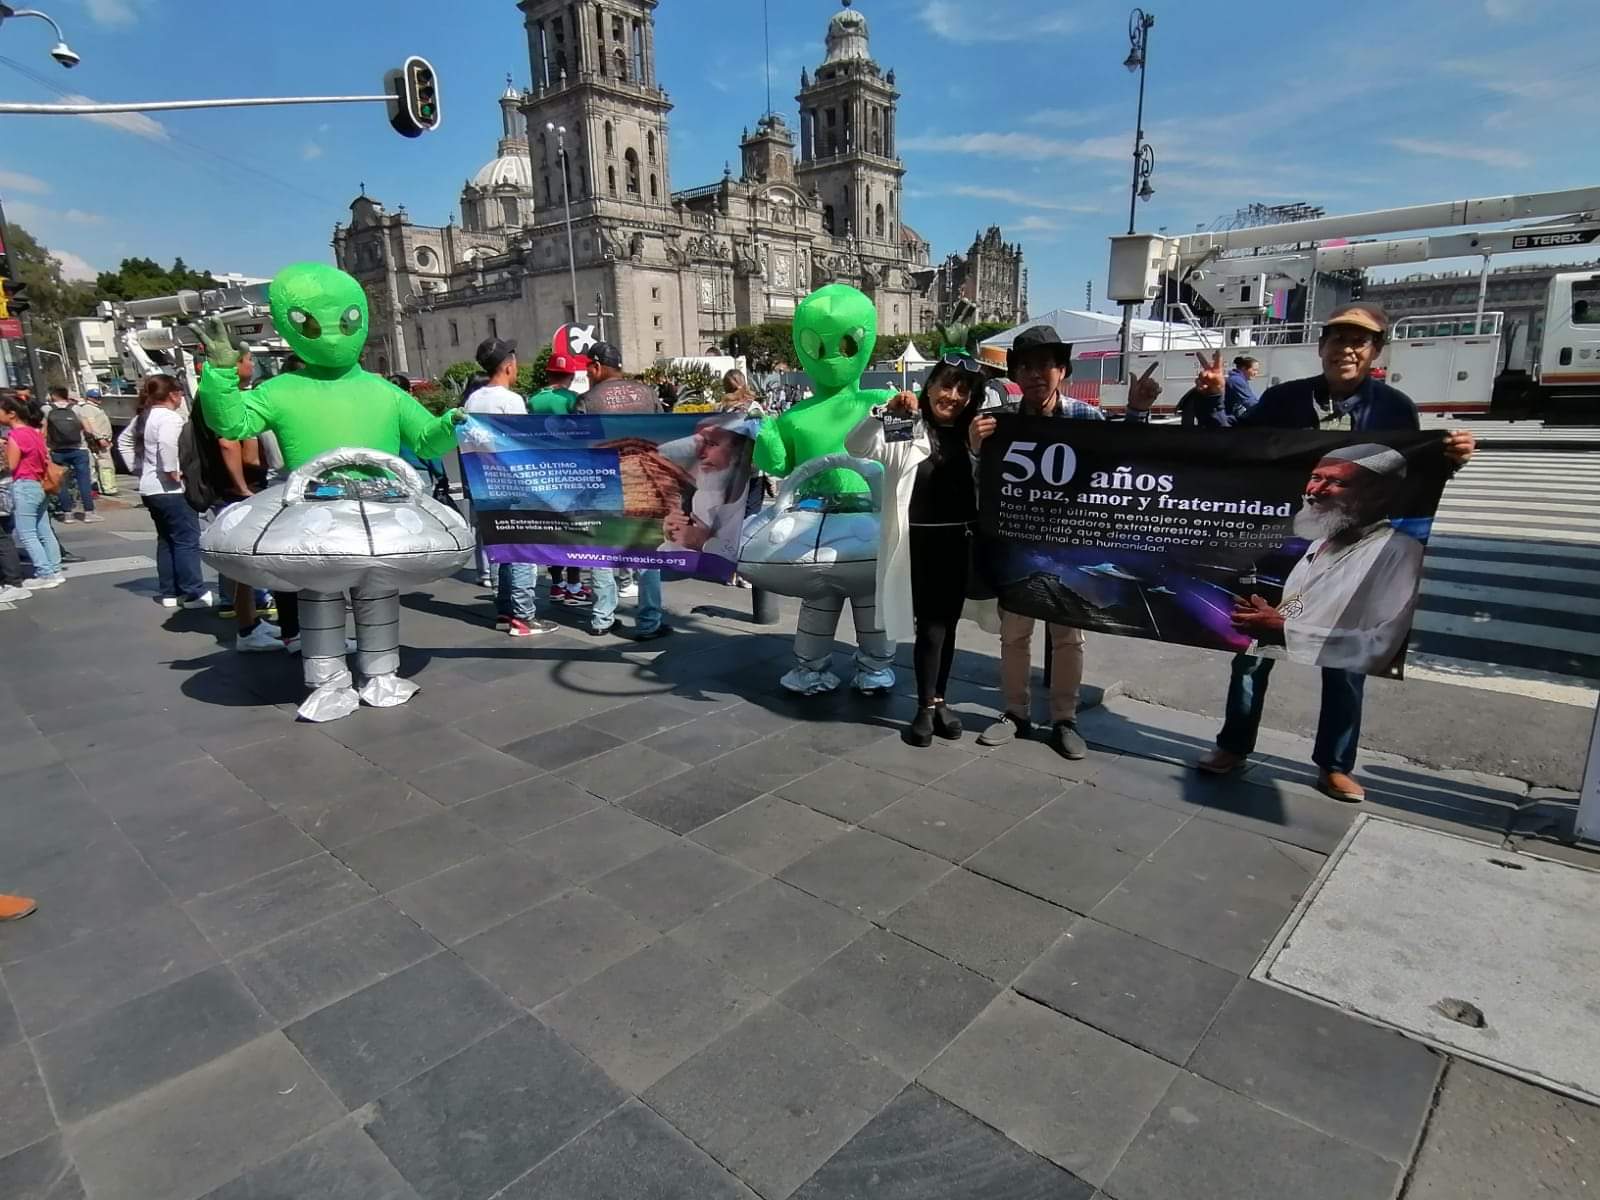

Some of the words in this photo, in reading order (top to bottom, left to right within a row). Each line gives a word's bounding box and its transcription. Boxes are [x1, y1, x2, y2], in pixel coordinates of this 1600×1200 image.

[1531, 233, 1581, 245] TEREX
[484, 470, 546, 479] MENSAJERO
[548, 469, 594, 477] ENVIADO
[596, 468, 616, 476] POR
[510, 464, 523, 472] ES
[539, 461, 577, 469] ÚLTIMO
[1001, 441, 1077, 486] 50
[486, 477, 539, 486] NUESTROS
[541, 476, 602, 484] CREADORES
[1090, 466, 1173, 492] años
[1001, 484, 1023, 497] de
[1029, 489, 1070, 504] paz,
[1077, 493, 1133, 506] amor
[1138, 496, 1151, 511] y
[1158, 494, 1291, 517] fraternidad
[1000, 501, 1026, 511] Rael
[1050, 507, 1062, 515] el
[1067, 508, 1108, 519] último
[1114, 513, 1187, 525] mensajero
[1194, 518, 1254, 530] enviado
[1261, 524, 1287, 533] por
[1000, 511, 1045, 523] nuestros
[1050, 517, 1111, 529] creadores
[1216, 529, 1234, 539] los
[998, 529, 1042, 541] mensaje
[1045, 533, 1069, 544] final
[1071, 537, 1080, 545] a
[1082, 537, 1093, 546] la
[1096, 538, 1168, 552] humanidad.
[1040, 525, 1072, 535] pidió
[1077, 529, 1101, 538] que
[1106, 531, 1141, 542] diera
[1145, 536, 1204, 546] conocer
[1224, 540, 1263, 549] todos
[1268, 541, 1283, 549] su
[566, 552, 686, 566] www.raelmexico.org
